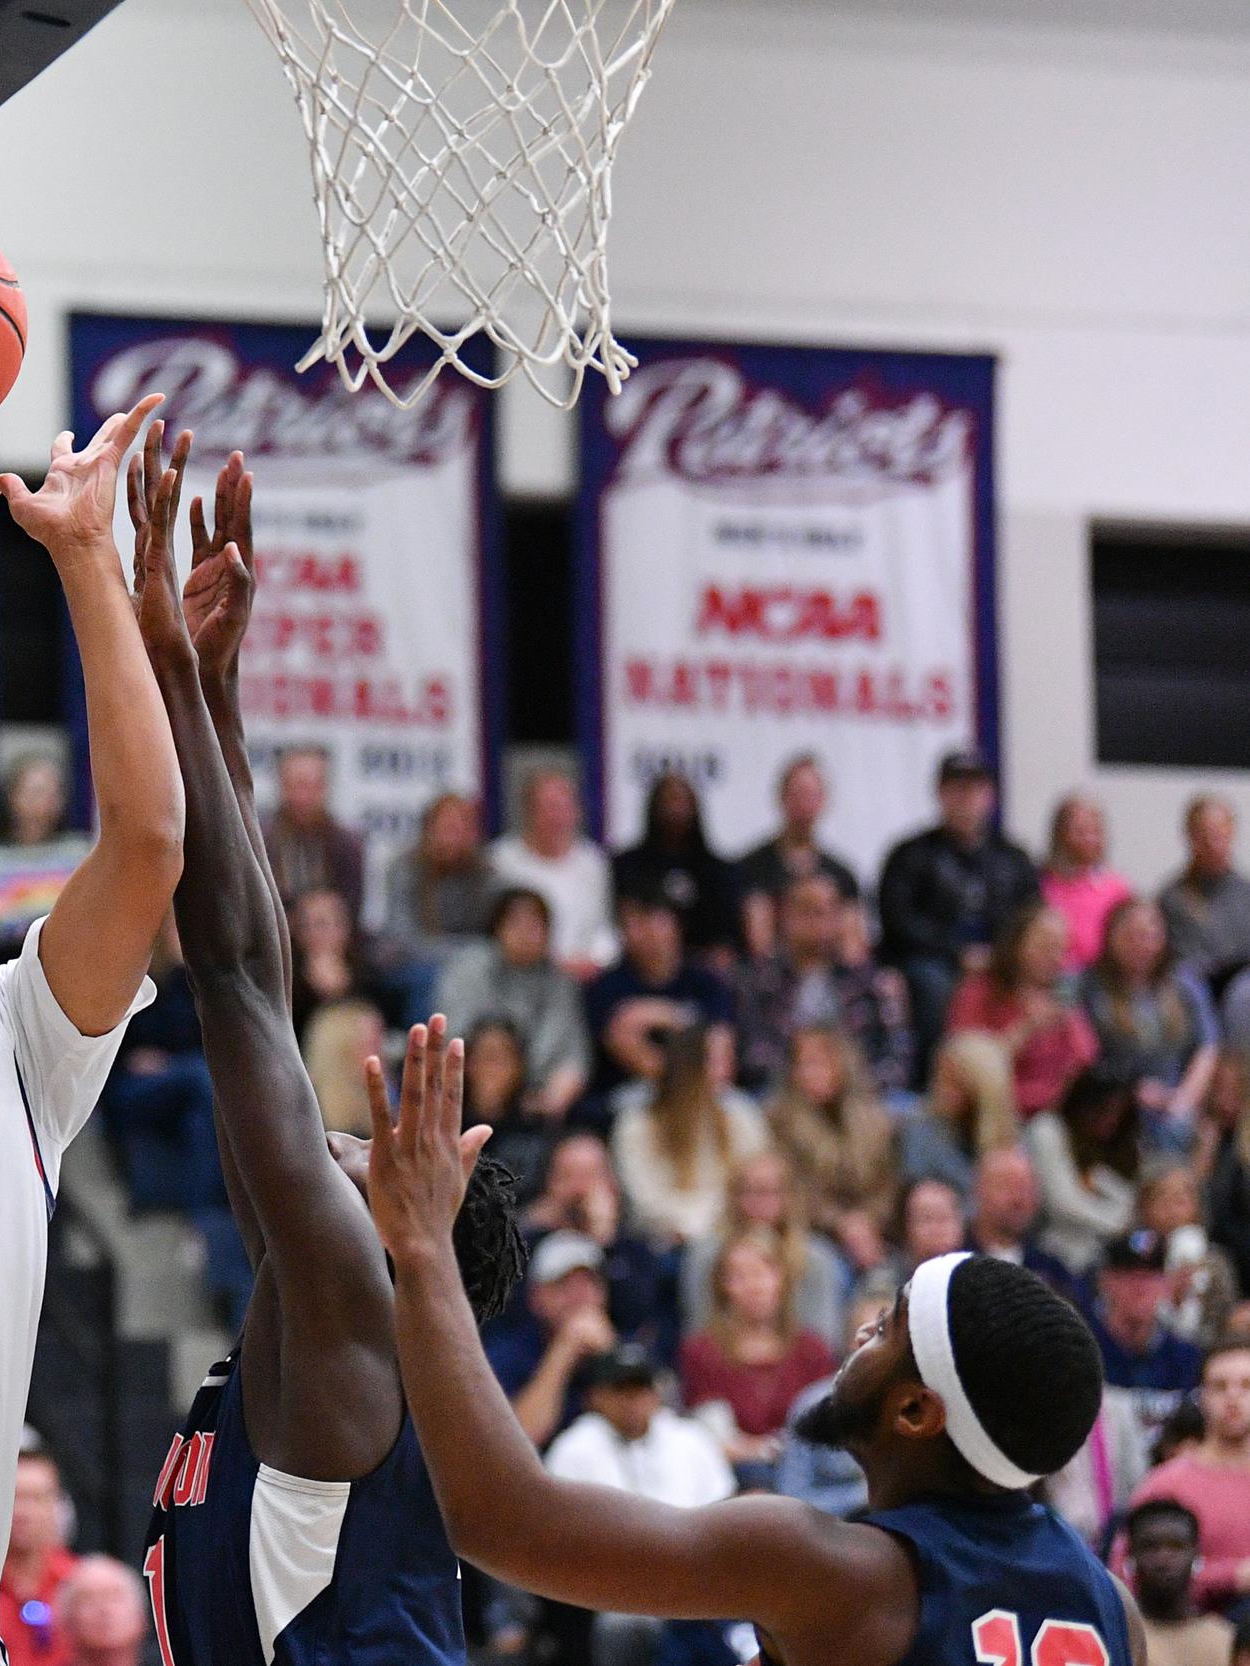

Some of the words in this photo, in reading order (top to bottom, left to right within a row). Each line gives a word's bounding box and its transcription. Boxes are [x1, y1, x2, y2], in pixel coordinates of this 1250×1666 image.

[604, 356, 974, 490] Patriots
[696, 580, 884, 643] NCAA
[625, 661, 953, 724] NATIONALS
